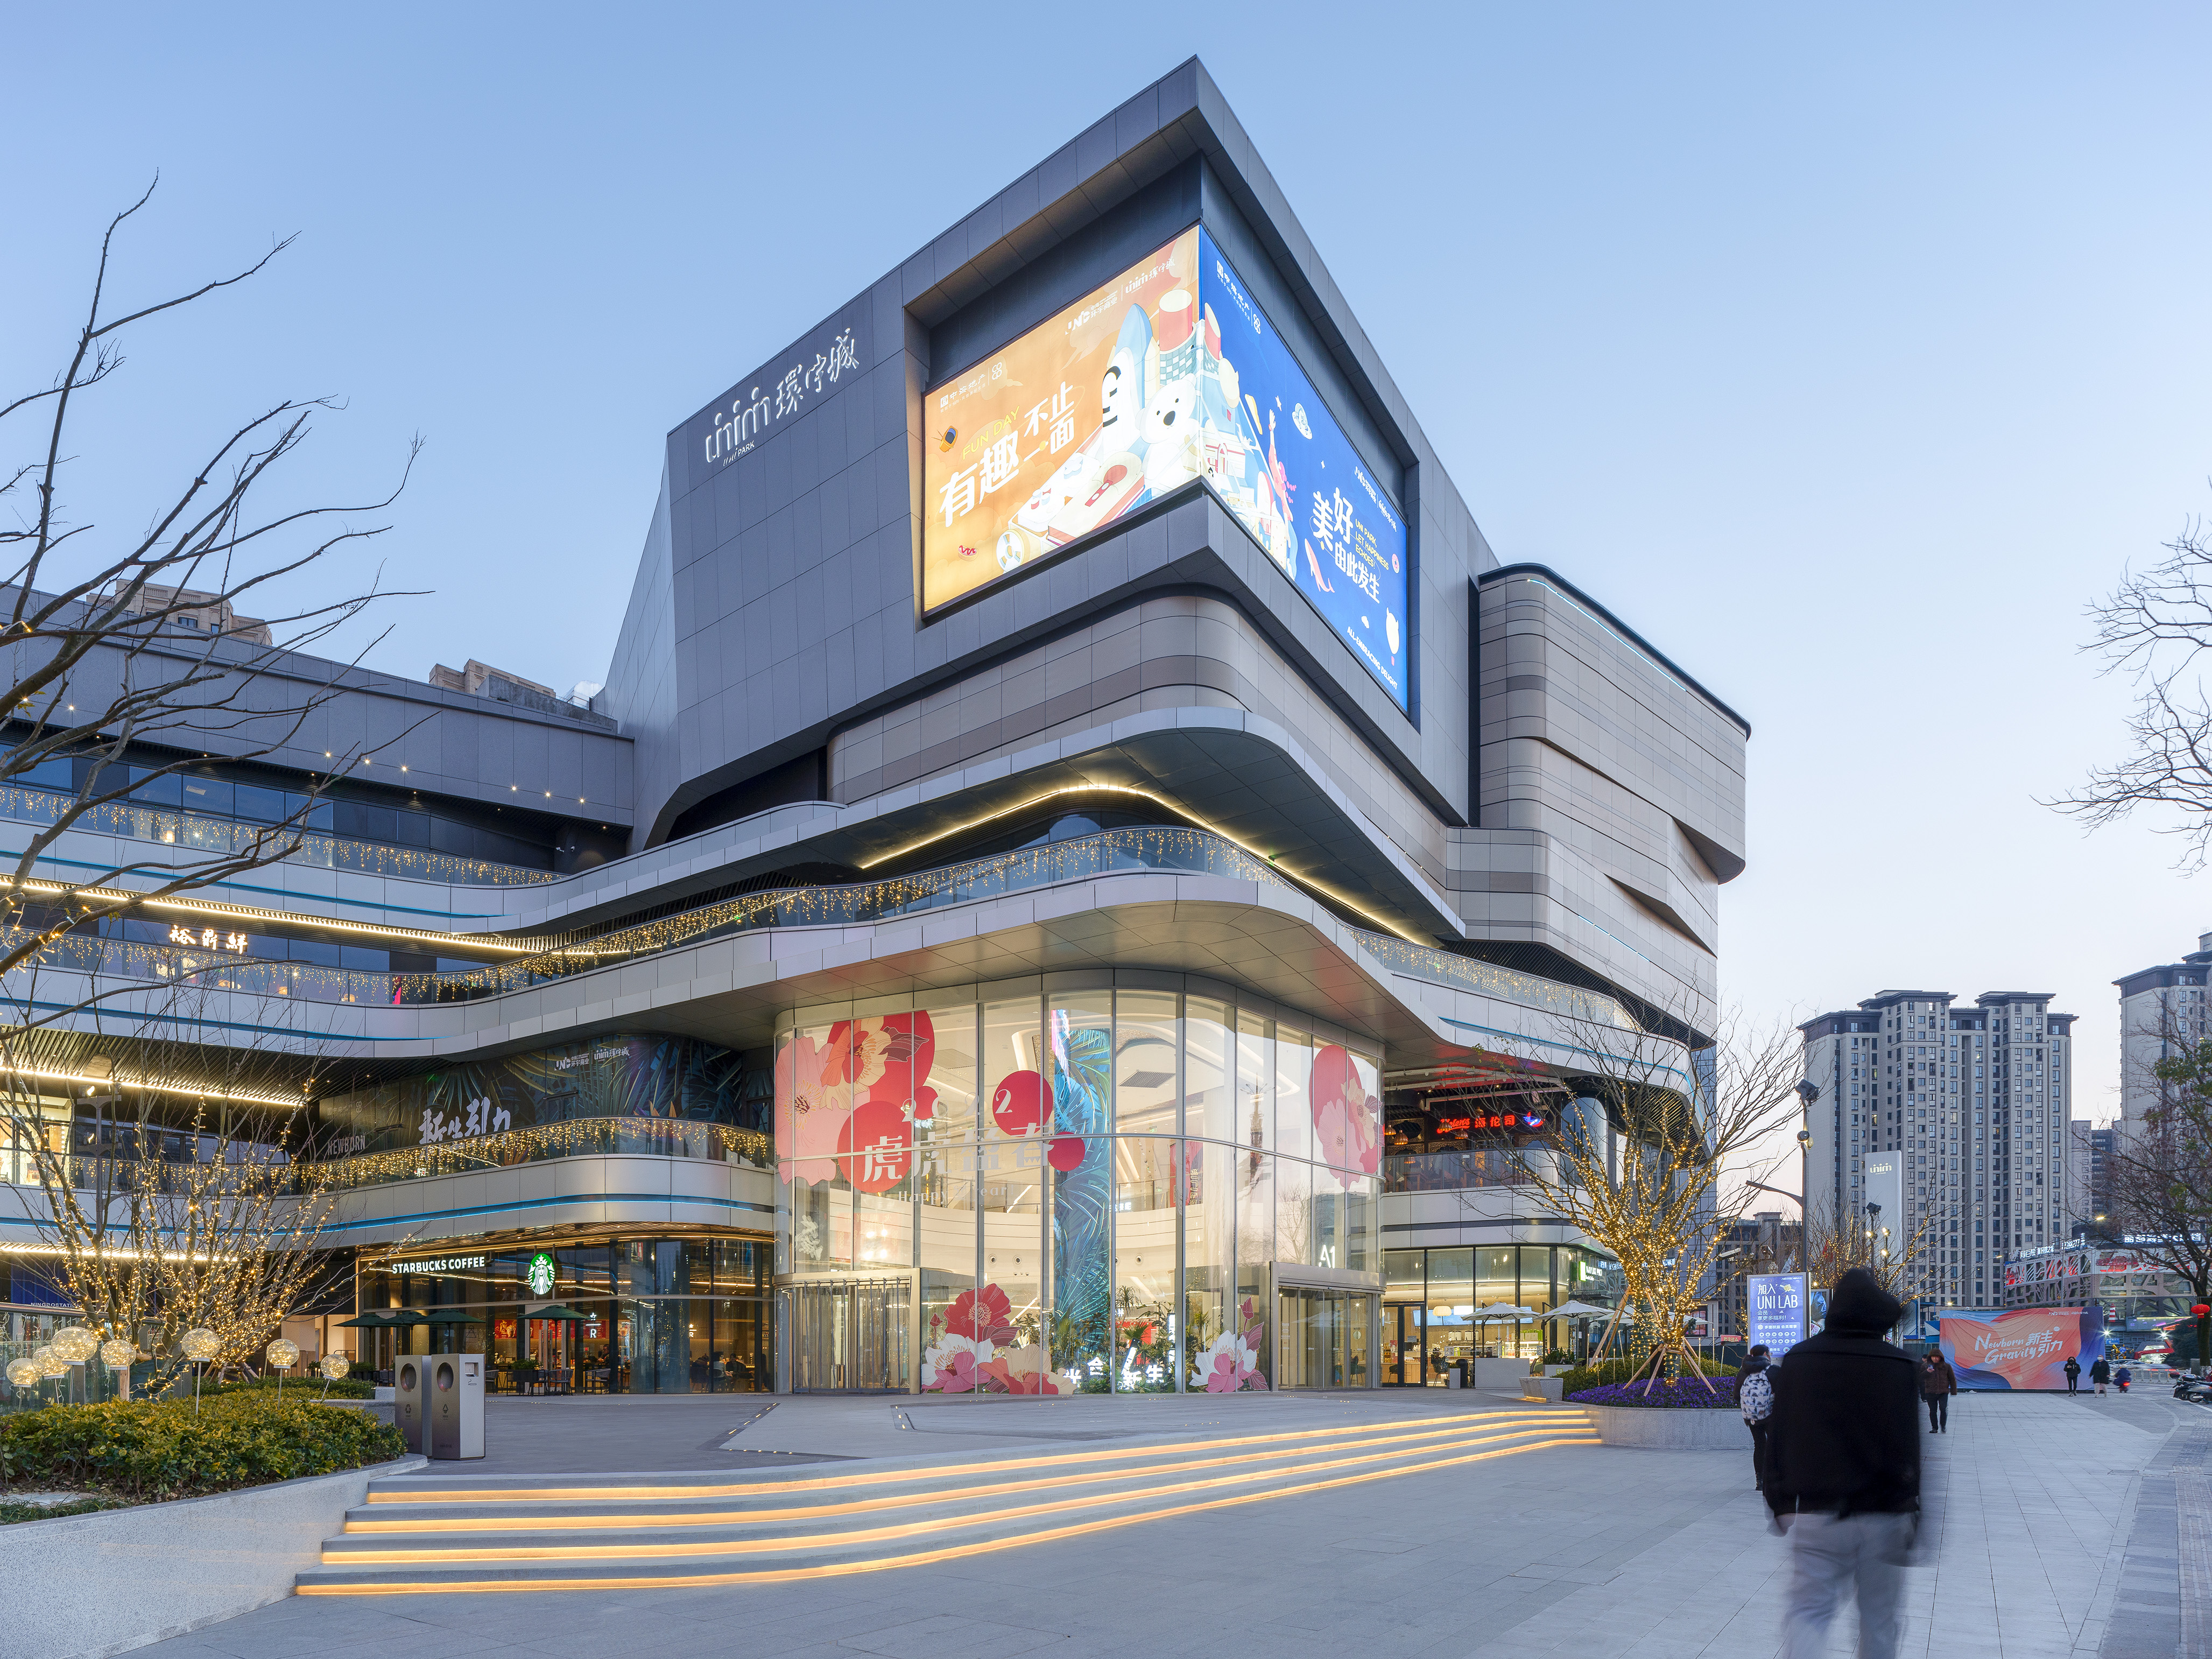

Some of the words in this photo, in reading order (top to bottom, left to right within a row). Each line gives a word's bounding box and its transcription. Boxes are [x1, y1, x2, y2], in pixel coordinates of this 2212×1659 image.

[1090, 296, 1118, 319] 环宇商业
[949, 374, 985, 400] 中海地产
[1024, 381, 1075, 437] 不止
[962, 430, 989, 460] FUN
[994, 405, 1020, 436] DAY
[1024, 409, 1075, 462] 一面
[738, 440, 755, 458] PARK
[939, 430, 1019, 528] 有趣
[1313, 487, 1353, 552] 美好
[1355, 518, 1363, 533] UNI
[1364, 528, 1377, 548] PARK,
[1355, 531, 1364, 545] LET
[1365, 540, 1389, 571] HAPPINESS
[1355, 543, 1375, 570] ECHOES!
[1335, 541, 1380, 604] 由此发生
[1347, 626, 1381, 670] ALL-EMBRACING
[1380, 665, 1398, 690] DELIGHT
[571, 1058, 589, 1067] 环宇商业
[901, 1088, 1013, 1122] 2022
[1436, 1118, 1470, 1134] elen's
[1475, 1115, 1516, 1128] 海伦司
[327, 1132, 365, 1156] NEWBORN
[898, 1191, 947, 1205] Happy
[392, 1259, 446, 1274] STARBUCKS
[448, 1256, 485, 1270] COFFEE
[1318, 1245, 1335, 1269] A1
[1757, 1283, 1776, 1295] 加入
[1757, 1295, 1776, 1310] UNI
[1778, 1295, 1798, 1309] LAB
[590, 1328, 596, 1338] R
[1975, 1333, 2024, 1351] Newborn
[2025, 1330, 2054, 1346] 新生
[1984, 1346, 2037, 1365] Gravity
[2038, 1340, 2063, 1358] 引力
